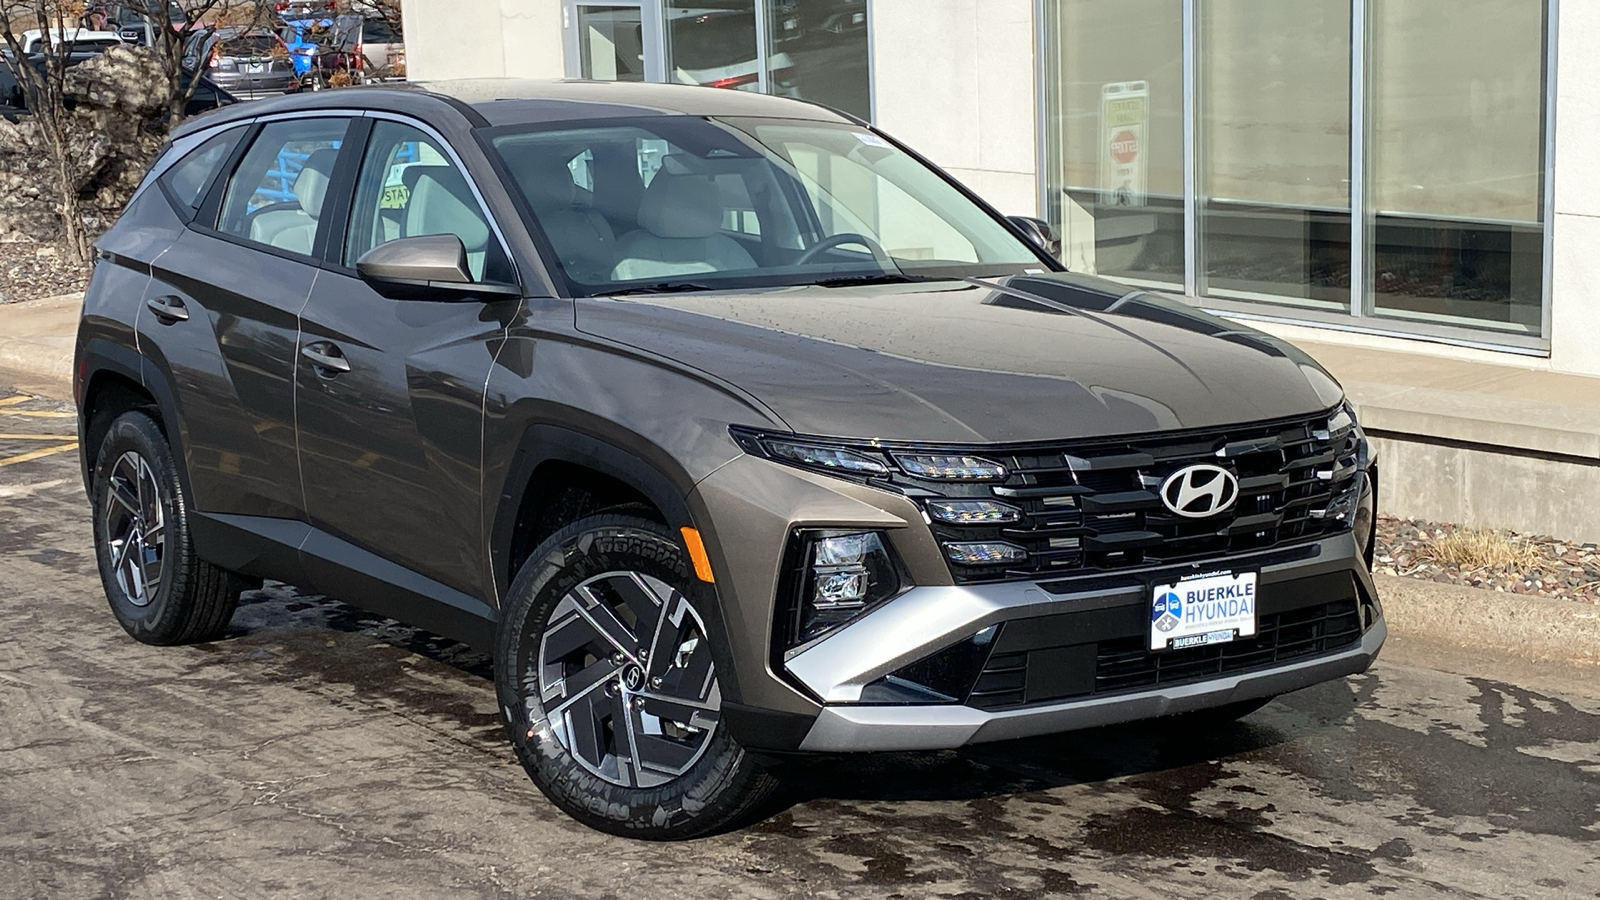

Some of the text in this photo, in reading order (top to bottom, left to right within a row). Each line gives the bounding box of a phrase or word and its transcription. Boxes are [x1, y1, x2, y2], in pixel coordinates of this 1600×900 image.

[1186, 583, 1254, 605] BUERKLE
[1185, 597, 1254, 624] HYUNDAI
[1174, 631, 1232, 648] BUERKLE HYUNDAI
